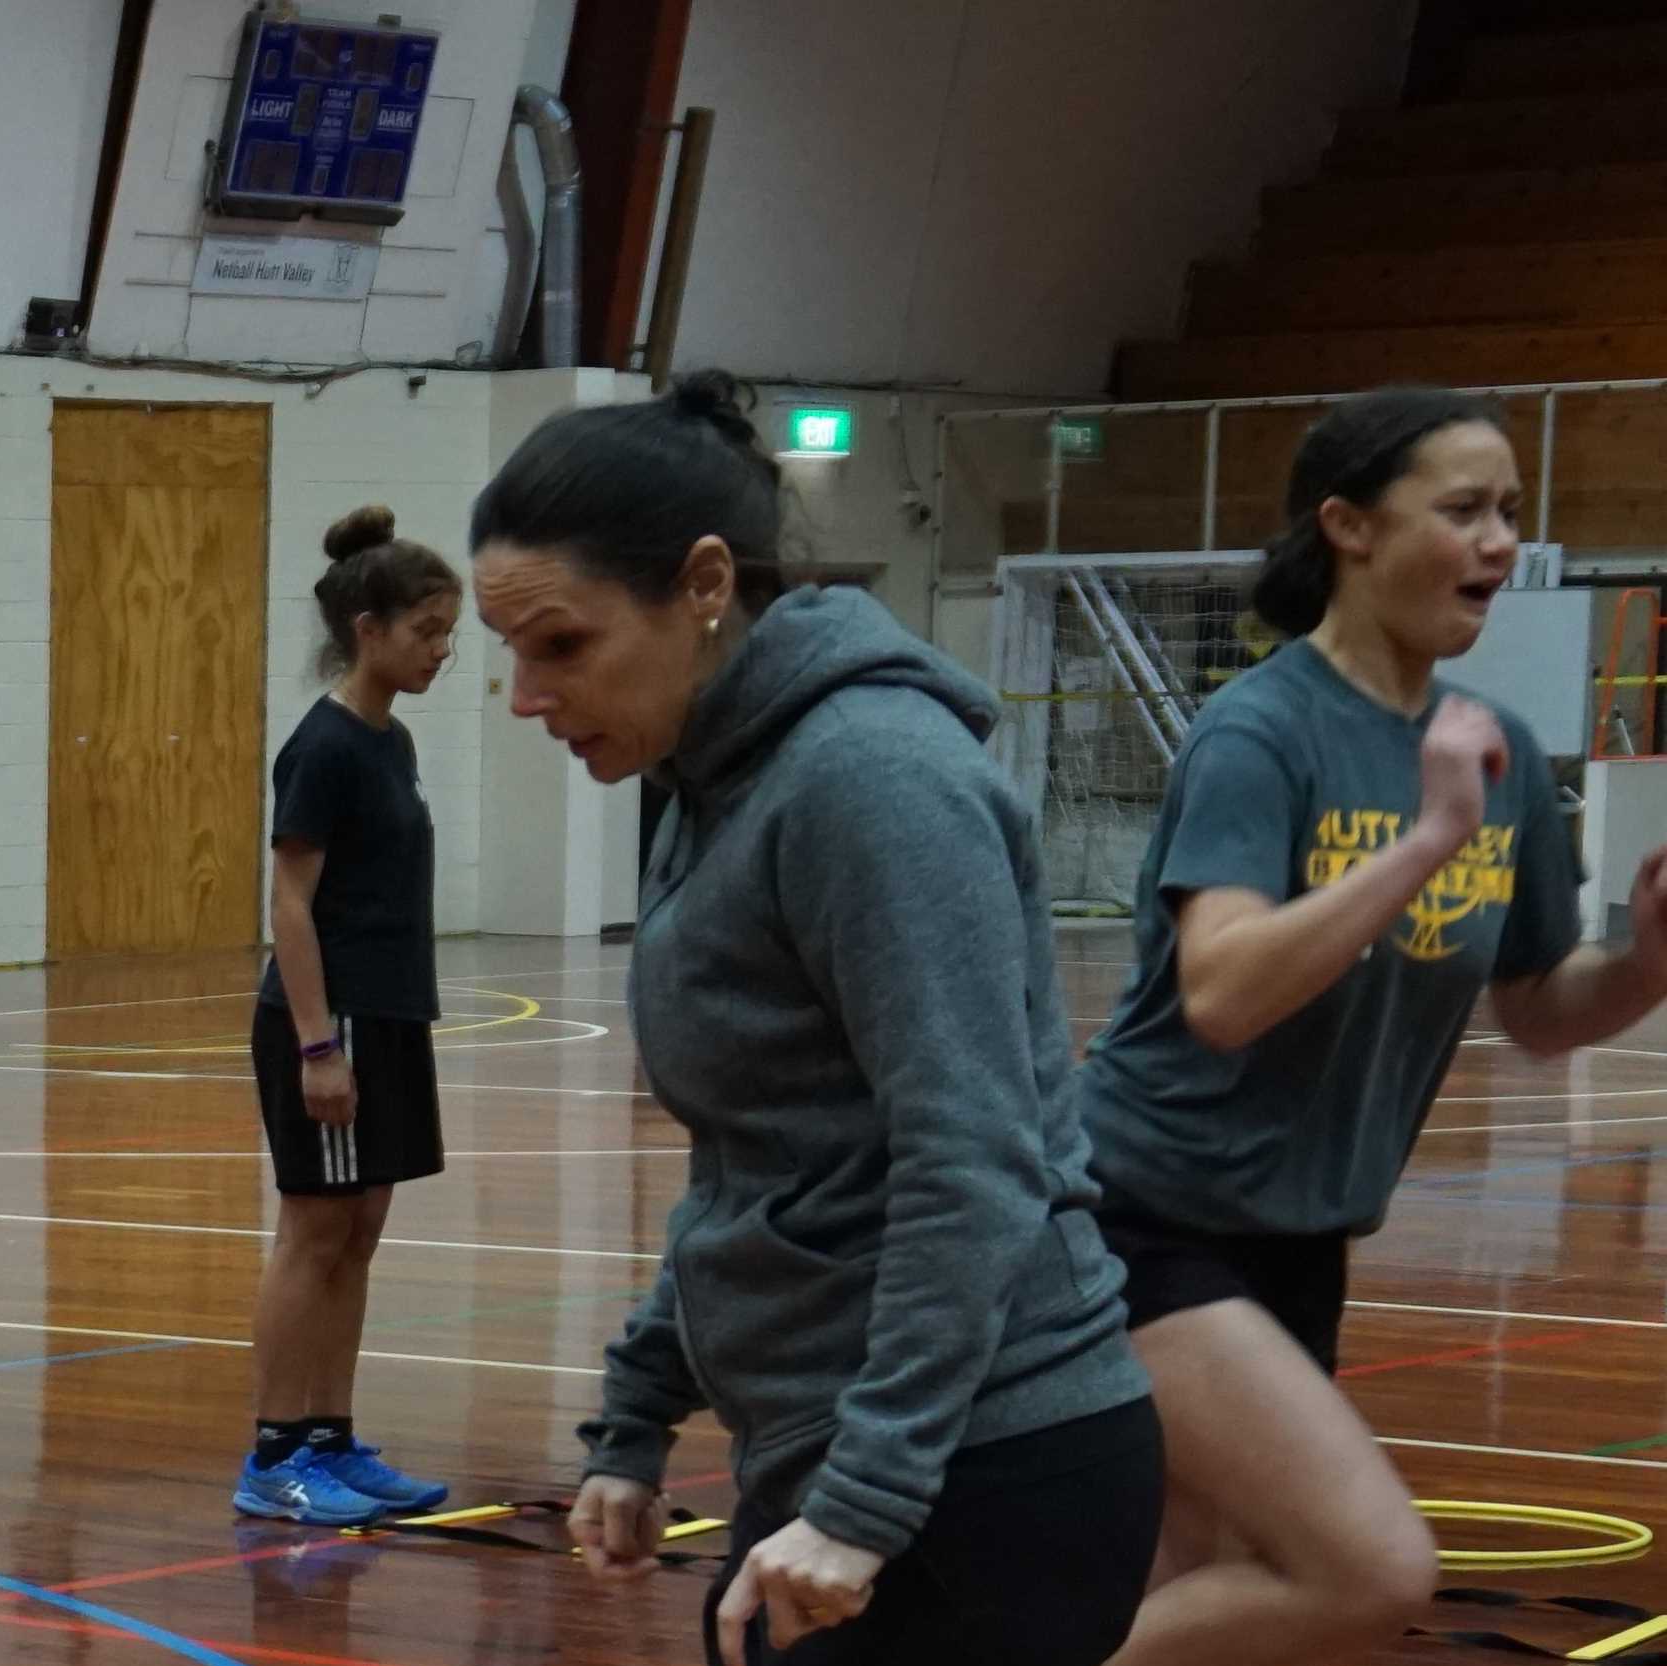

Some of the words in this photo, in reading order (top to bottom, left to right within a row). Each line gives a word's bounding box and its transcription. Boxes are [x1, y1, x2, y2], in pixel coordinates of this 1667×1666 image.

[251, 98, 294, 118] LIGHT
[378, 110, 416, 128] DARK
[212, 259, 255, 279] Netball
[255, 261, 280, 280] Hutt
[283, 261, 315, 286] Valley
